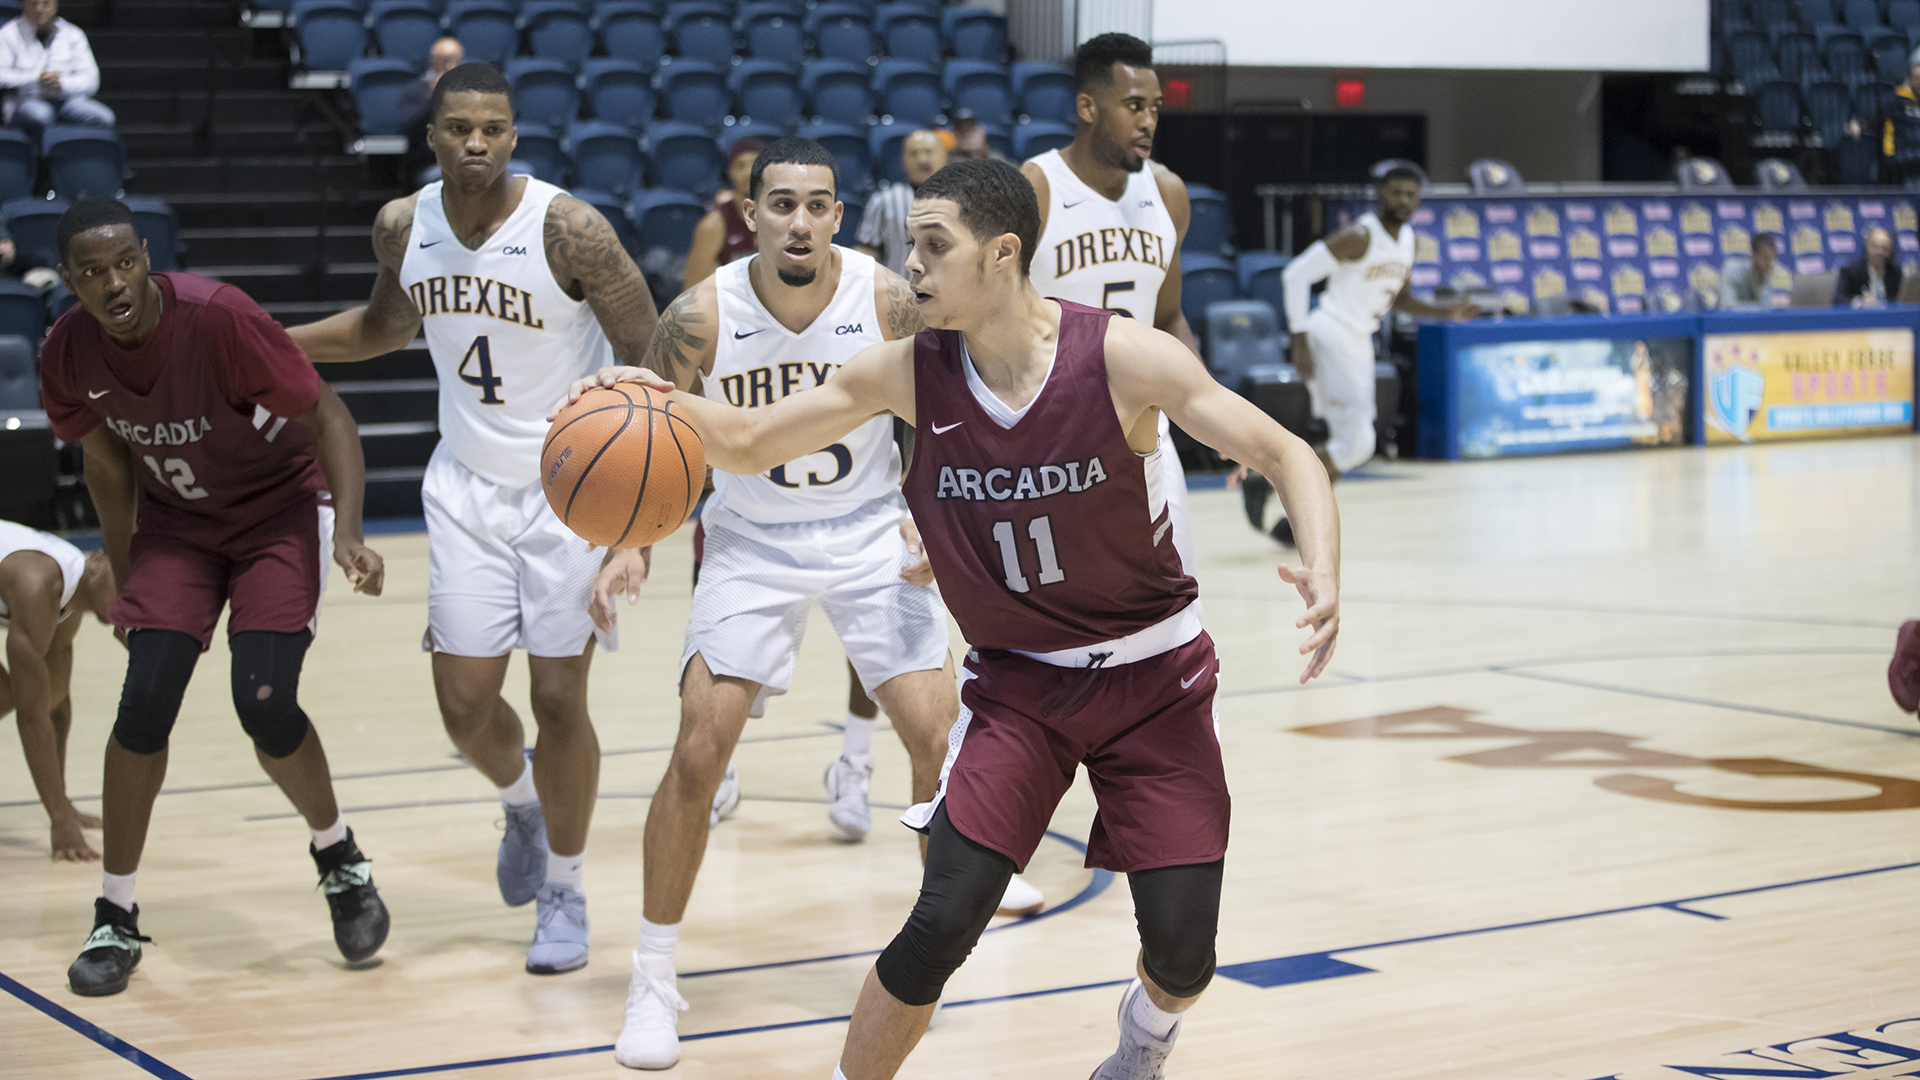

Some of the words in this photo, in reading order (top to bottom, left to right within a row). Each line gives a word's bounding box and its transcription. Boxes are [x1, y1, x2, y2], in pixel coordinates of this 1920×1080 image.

[502, 246, 526, 256] CAA
[1053, 227, 1168, 280] DREXEL
[408, 274, 544, 330] DREXEL
[1102, 280, 1135, 319] 5
[835, 323, 863, 336] CAA
[457, 334, 505, 406] 4
[719, 361, 843, 409] DREX
[105, 415, 213, 446] ARCADIA
[143, 455, 209, 500] 12
[936, 456, 1107, 501] ARCADIA
[992, 515, 1065, 593] 11
